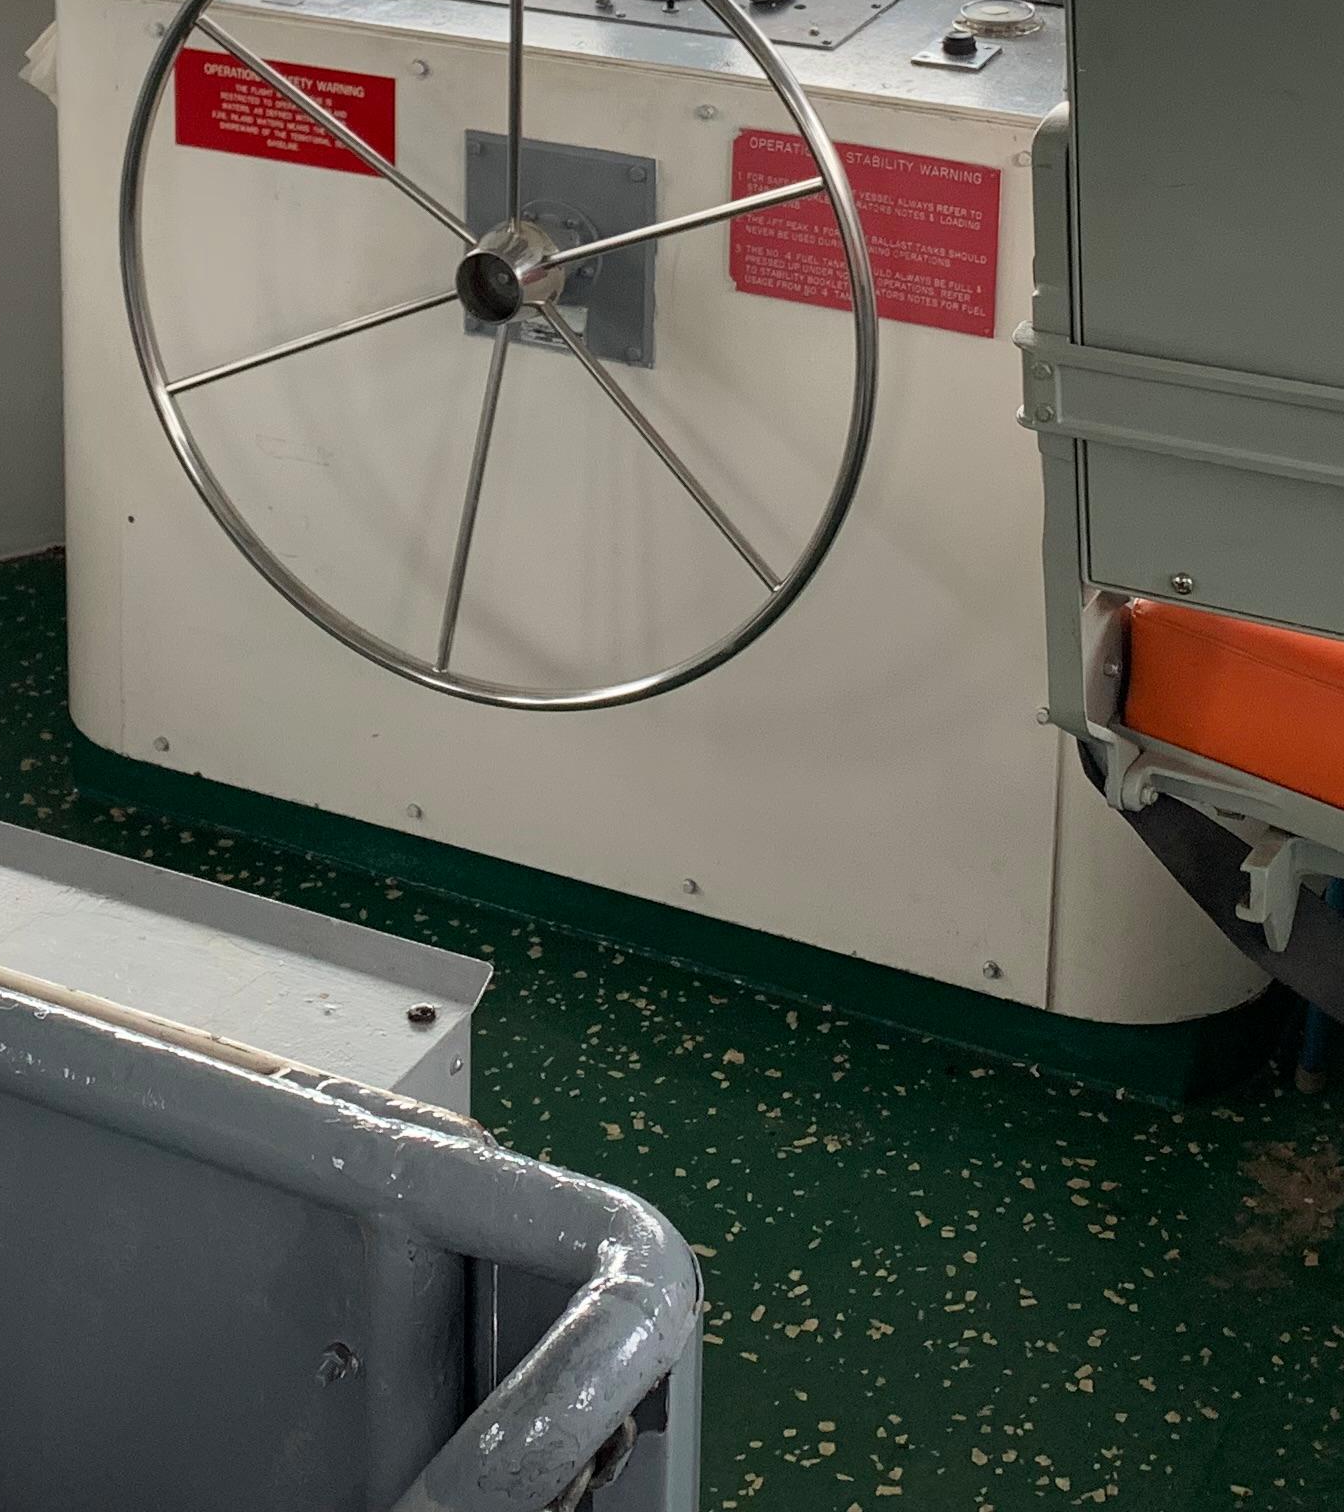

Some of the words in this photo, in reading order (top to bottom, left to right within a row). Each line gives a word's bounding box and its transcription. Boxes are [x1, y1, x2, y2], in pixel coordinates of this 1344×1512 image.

[316, 79, 364, 97] WARNING
[846, 150, 914, 173] STABILITY
[918, 162, 981, 185] WARNING
[746, 171, 764, 183] FOR
[858, 190, 893, 205] VESSEL
[897, 197, 934, 212] ALWAYS
[935, 203, 967, 217] REFER
[970, 209, 982, 220] TO
[894, 207, 925, 220] NOTES
[939, 214, 980, 230] LOADING
[745, 224, 774, 237] NEVER
[776, 229, 789, 240] BE
[791, 232, 815, 244] USED
[893, 249, 951, 268] OPERATIONS
[746, 213, 764, 224] THE
[786, 220, 809, 232] PEAK
[870, 235, 912, 251] BALLAST
[915, 243, 945, 257] TANKS
[948, 249, 987, 265] SHOULD
[744, 253, 784, 268] PRESSED
[787, 261, 800, 271] UP
[802, 264, 833, 278] UNDER
[940, 289, 971, 303] REFER
[744, 273, 774, 287] USAGE
[776, 279, 801, 292] FROM
[745, 264, 757, 274] TO
[759, 266, 803, 283] STABILITY
[906, 293, 938, 308] NOTES
[940, 300, 959, 312] FOR
[961, 304, 986, 317] FUEL
[746, 244, 763, 255] THE
[795, 253, 819, 265] FUEL
[894, 271, 931, 285] ALWAYS
[934, 277, 946, 288] BE
[948, 280, 973, 294] FULL
